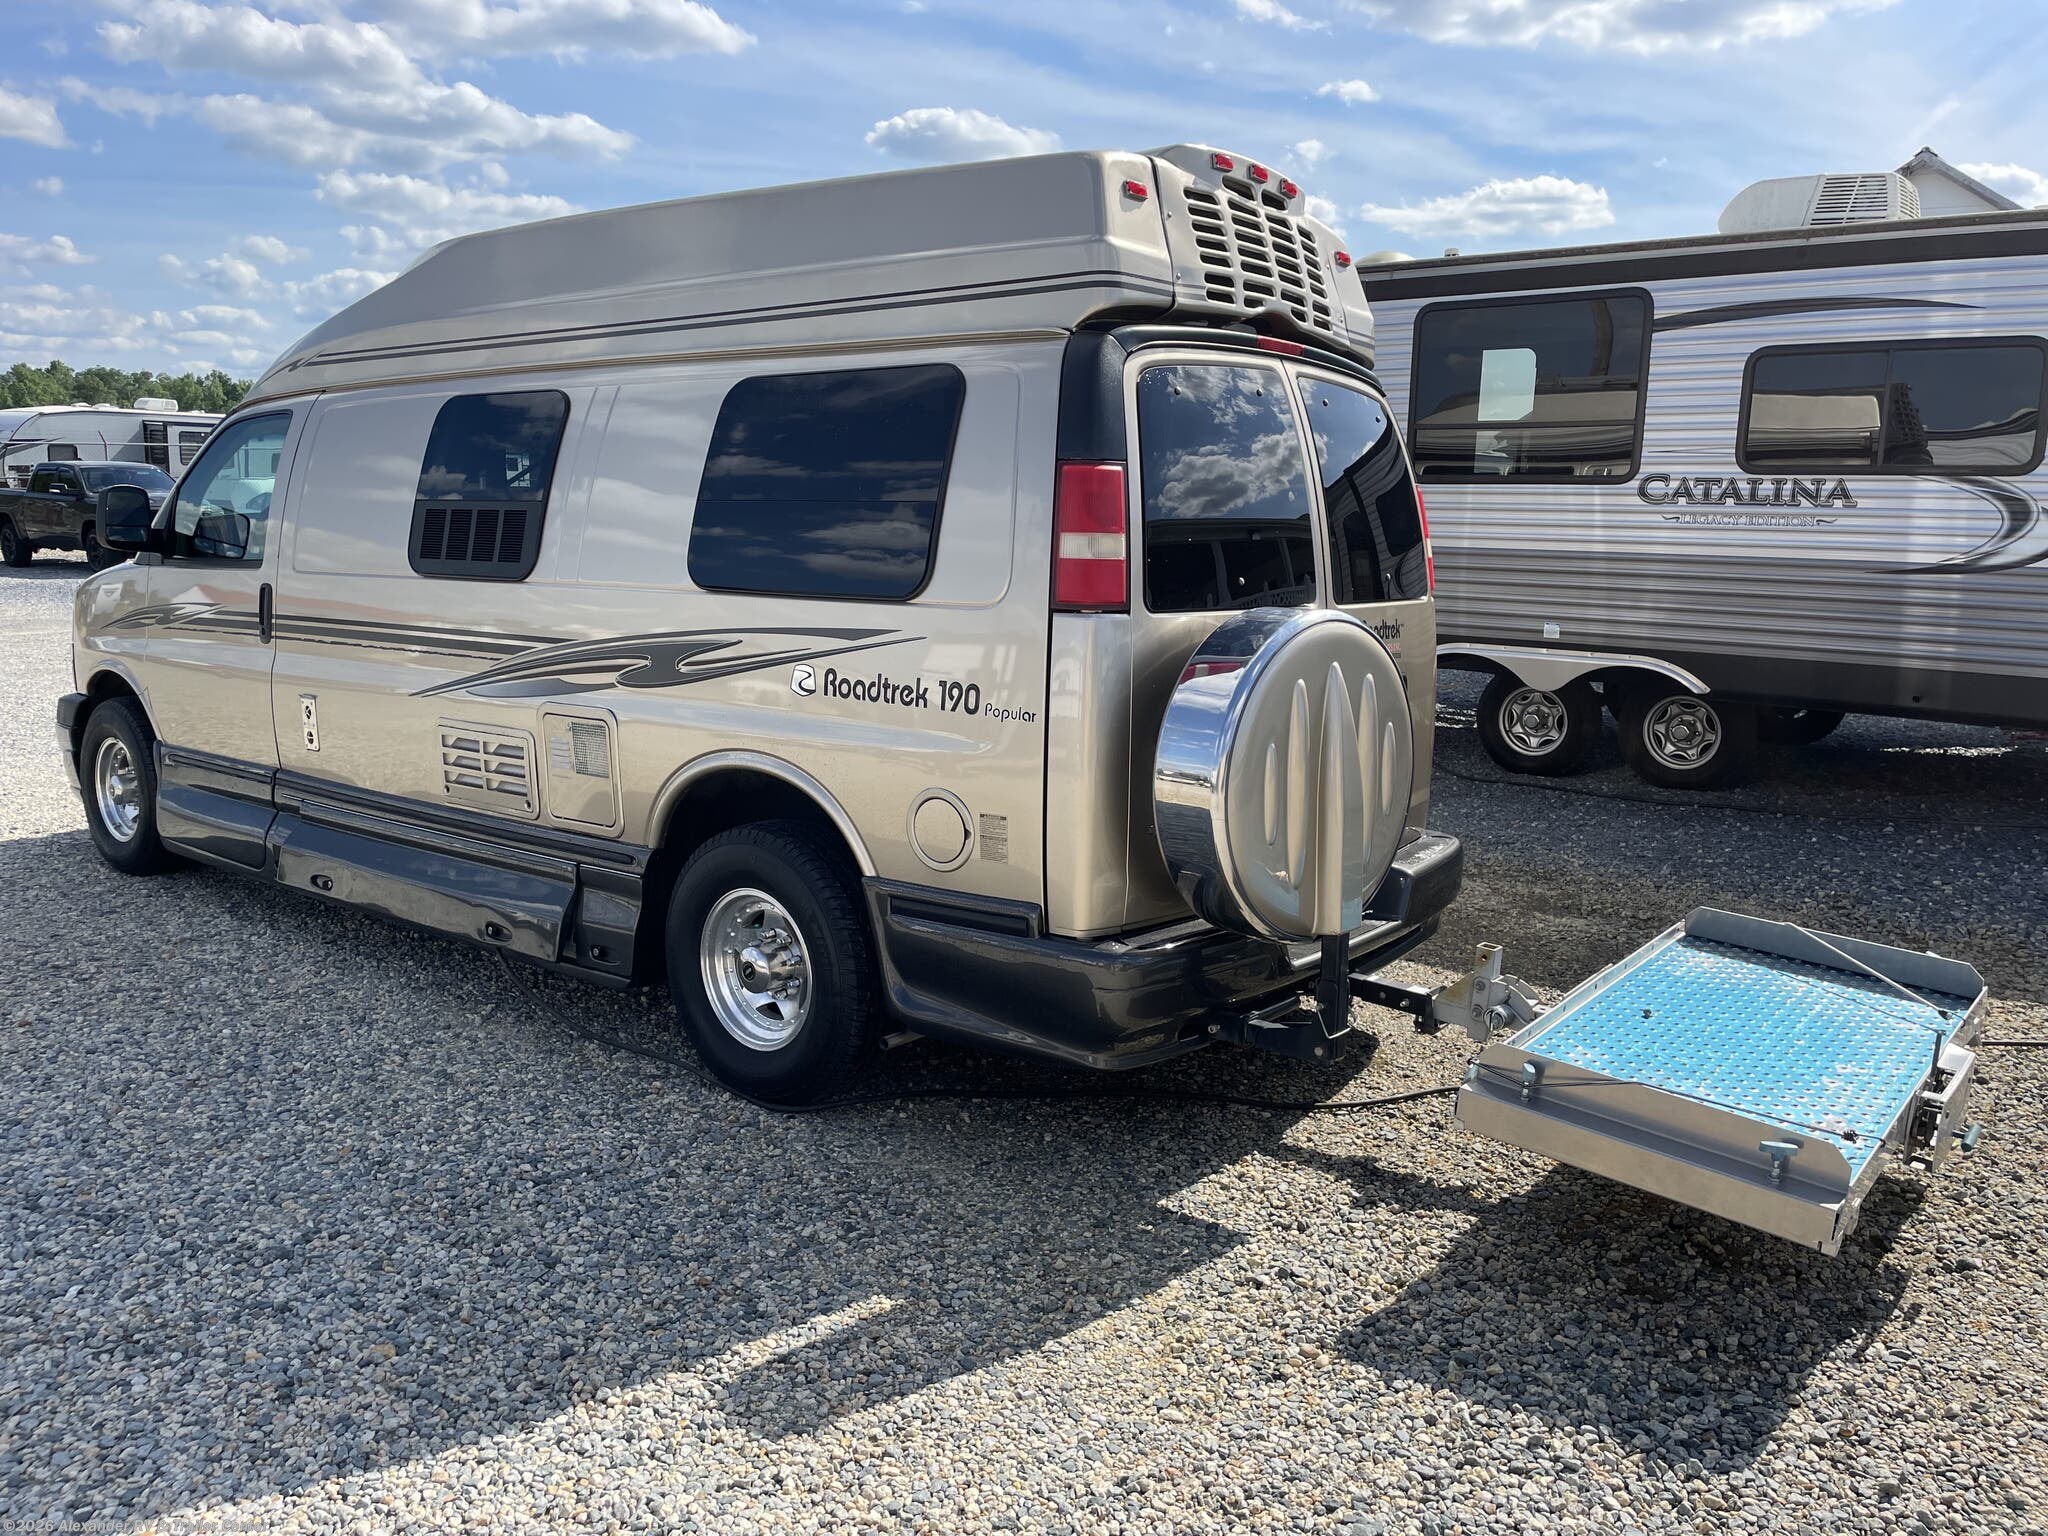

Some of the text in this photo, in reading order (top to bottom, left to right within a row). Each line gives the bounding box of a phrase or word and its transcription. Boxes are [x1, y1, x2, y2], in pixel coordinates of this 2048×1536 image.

[1637, 473, 1858, 508] CATALINA
[1680, 512, 1816, 527] LEGACY EDITION
[823, 667, 1037, 723] Roadtrek 190 Popular
